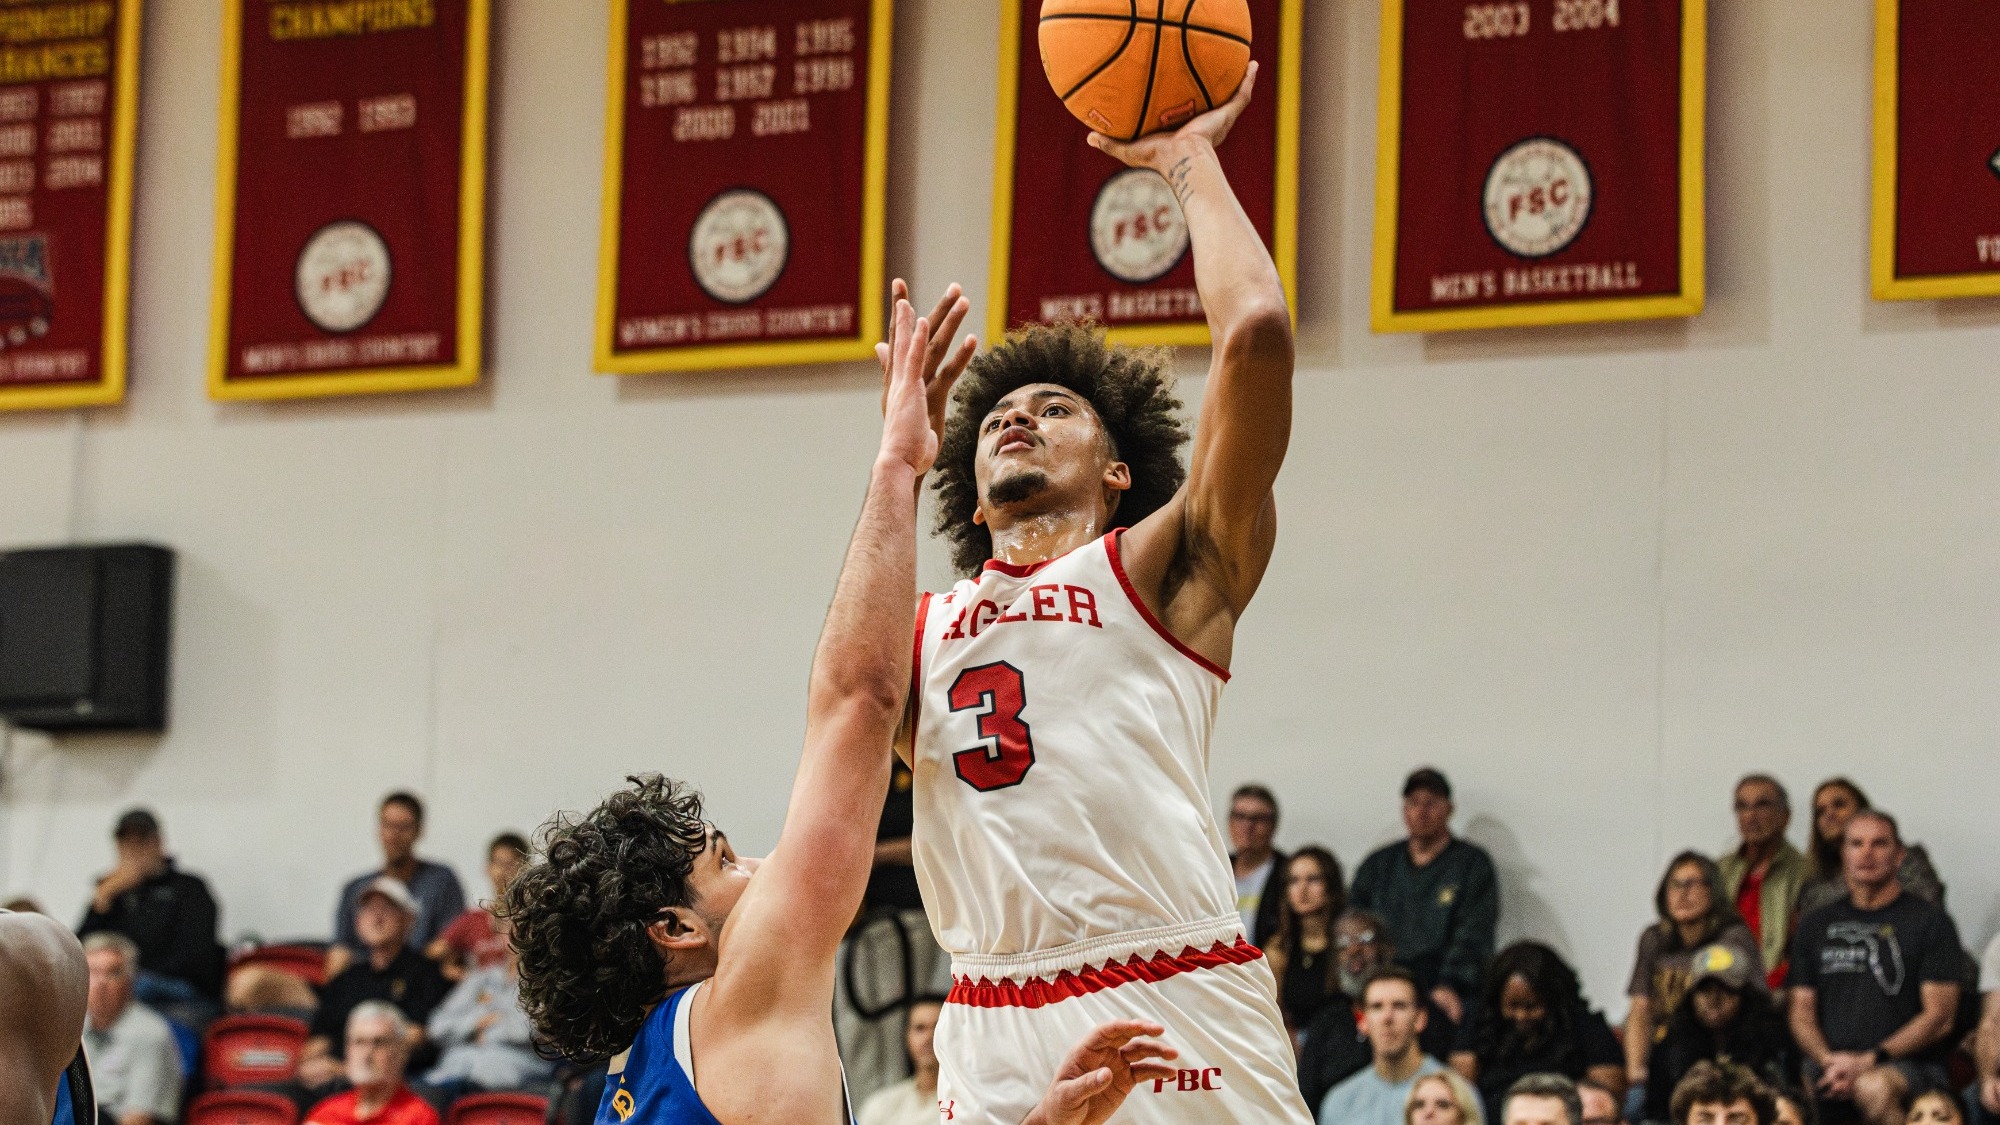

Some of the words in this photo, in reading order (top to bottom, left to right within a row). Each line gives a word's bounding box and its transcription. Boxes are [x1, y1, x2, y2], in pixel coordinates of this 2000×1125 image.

[1463, 4, 1530, 39] 2003
[1553, 0, 1619, 32] 2004
[1509, 179, 1569, 222] FSC
[1113, 205, 1170, 245] FSC
[715, 228, 766, 263] FSC
[1430, 271, 1497, 301] MEN'S
[1504, 262, 1641, 295] BASKETBALL
[1109, 288, 1203, 320] BASKETB
[947, 660, 1036, 792] 3
[1154, 1067, 1222, 1093] PBC
